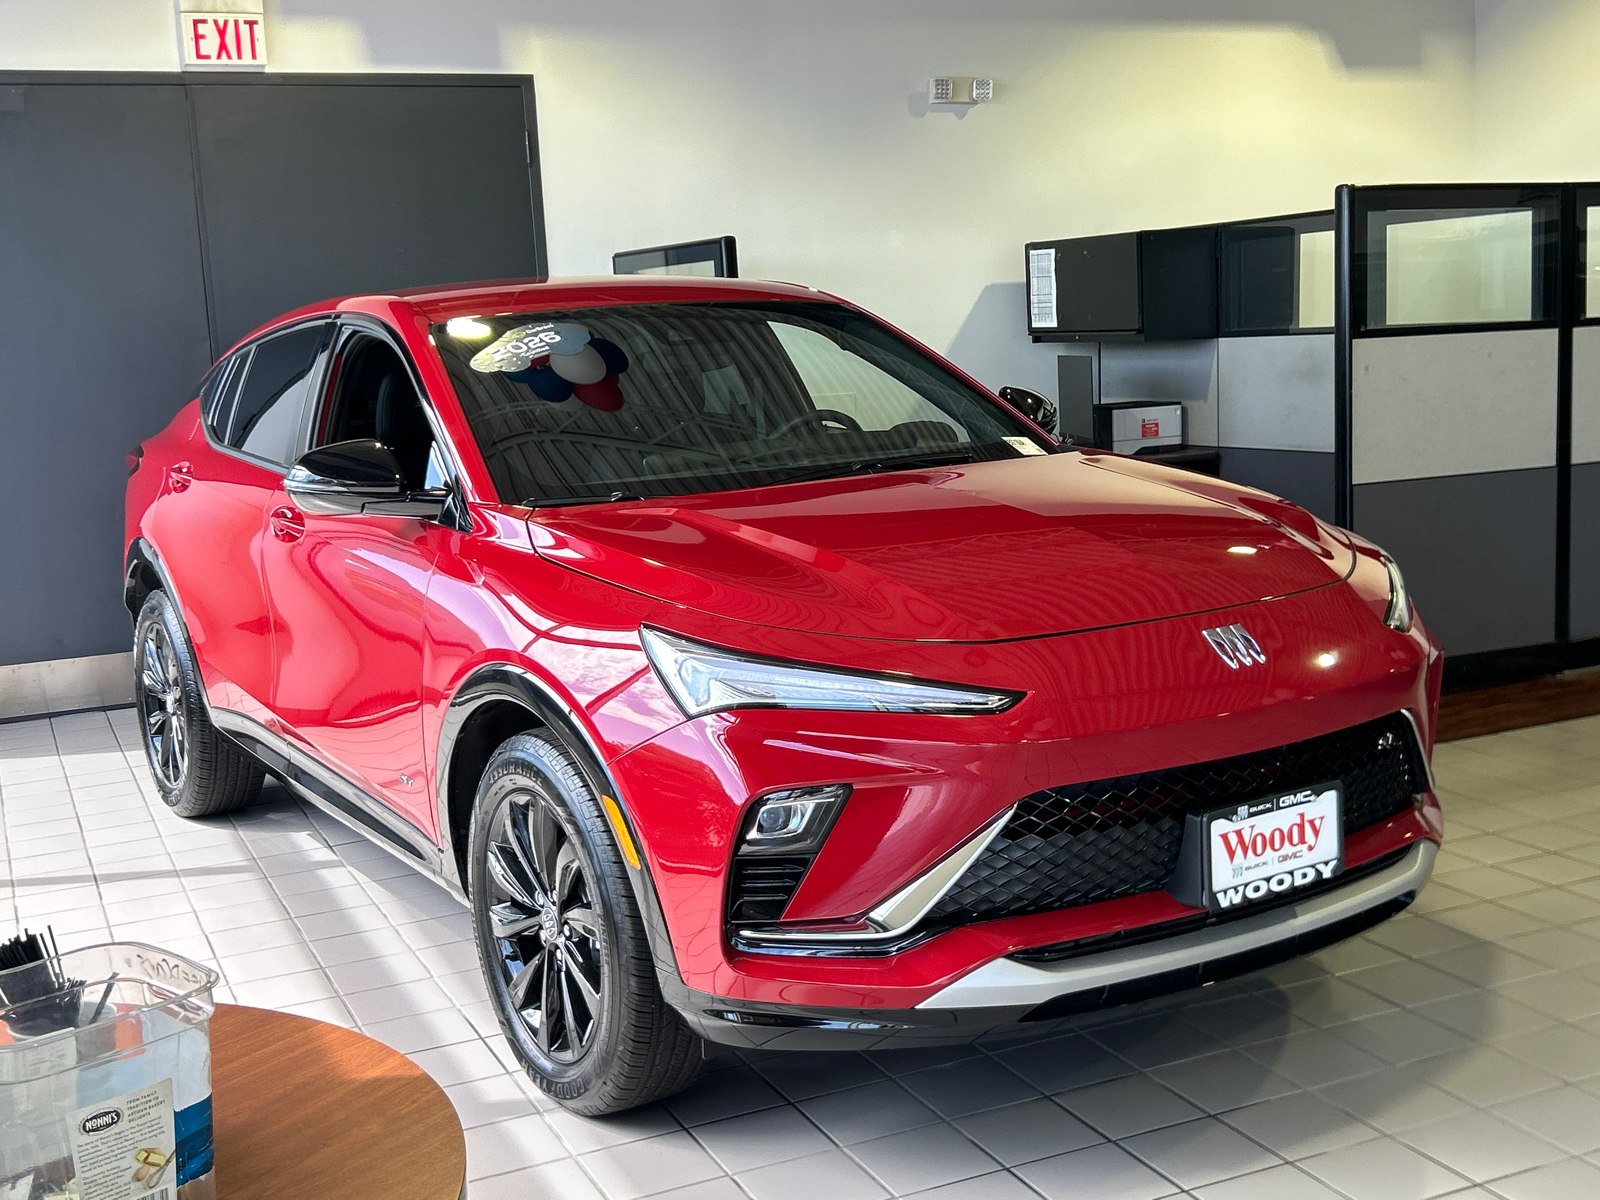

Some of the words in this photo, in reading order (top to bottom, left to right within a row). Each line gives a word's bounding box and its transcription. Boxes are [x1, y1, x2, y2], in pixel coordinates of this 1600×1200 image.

[192, 19, 259, 60] EXIT
[1250, 802, 1272, 812] BUICK
[1279, 790, 1313, 808] GMC
[1218, 812, 1326, 865] Woody
[1245, 860, 1268, 871] BUICK
[1277, 850, 1304, 864] GMC
[1216, 859, 1339, 909] WOODY
[85, 1112, 118, 1131] NONNI'S
